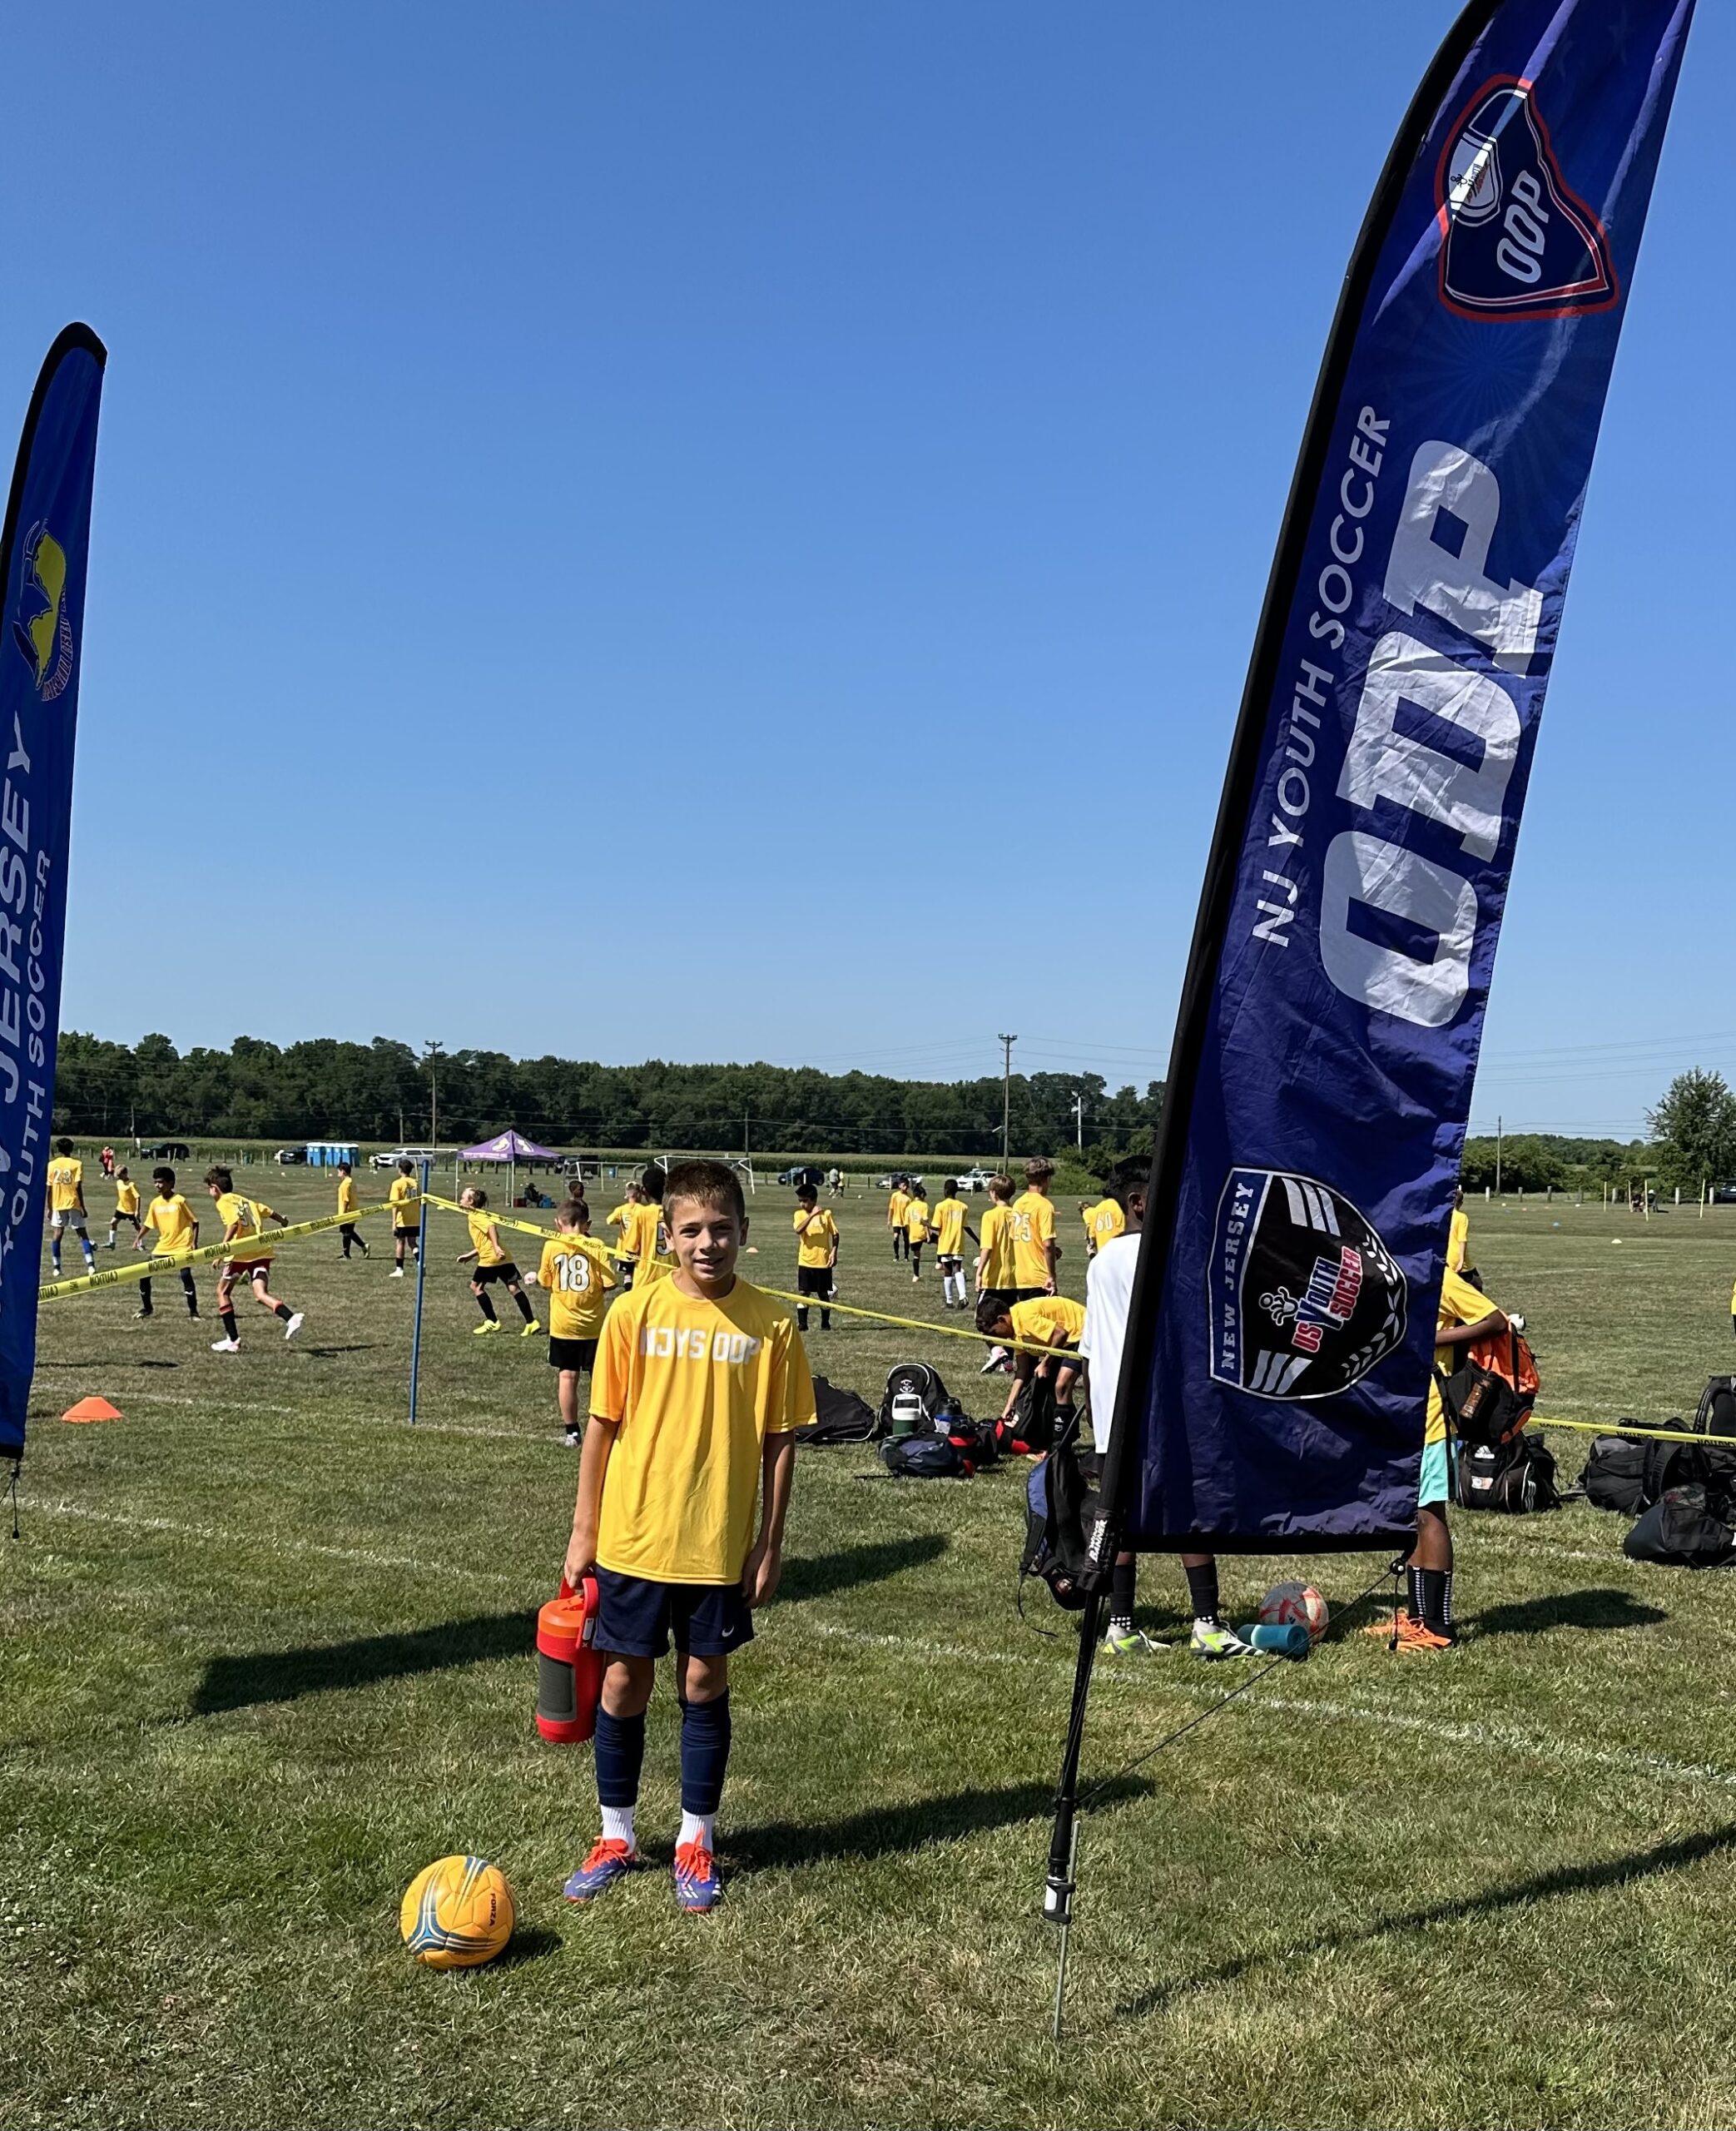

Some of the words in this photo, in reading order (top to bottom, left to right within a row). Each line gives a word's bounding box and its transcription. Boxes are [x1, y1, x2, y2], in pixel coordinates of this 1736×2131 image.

[1497, 170, 1549, 284] ODP
[1308, 404, 1391, 650] SOCCER
[1267, 663, 1335, 853] YOUTH
[1319, 440, 1545, 1028] ODP
[1252, 869, 1298, 948] NJ
[2, 1080, 46, 1255] YOUTH
[27, 850, 51, 1068] SOCCER
[53, 1168, 72, 1185] 23
[1095, 1211, 1114, 1231] 60
[1223, 1182, 1254, 1291] JERSEY
[553, 1253, 590, 1292] 18
[1294, 1255, 1346, 1331] YOUTH
[1329, 1244, 1364, 1321] SOCCER
[639, 1326, 707, 1359] NJYS
[712, 1332, 761, 1364] ODP
[1221, 1303, 1236, 1369] NEW
[1292, 1320, 1323, 1354] US
[1089, 1519, 1108, 1562] BANNER
[489, 1893, 497, 1926] FORZA
